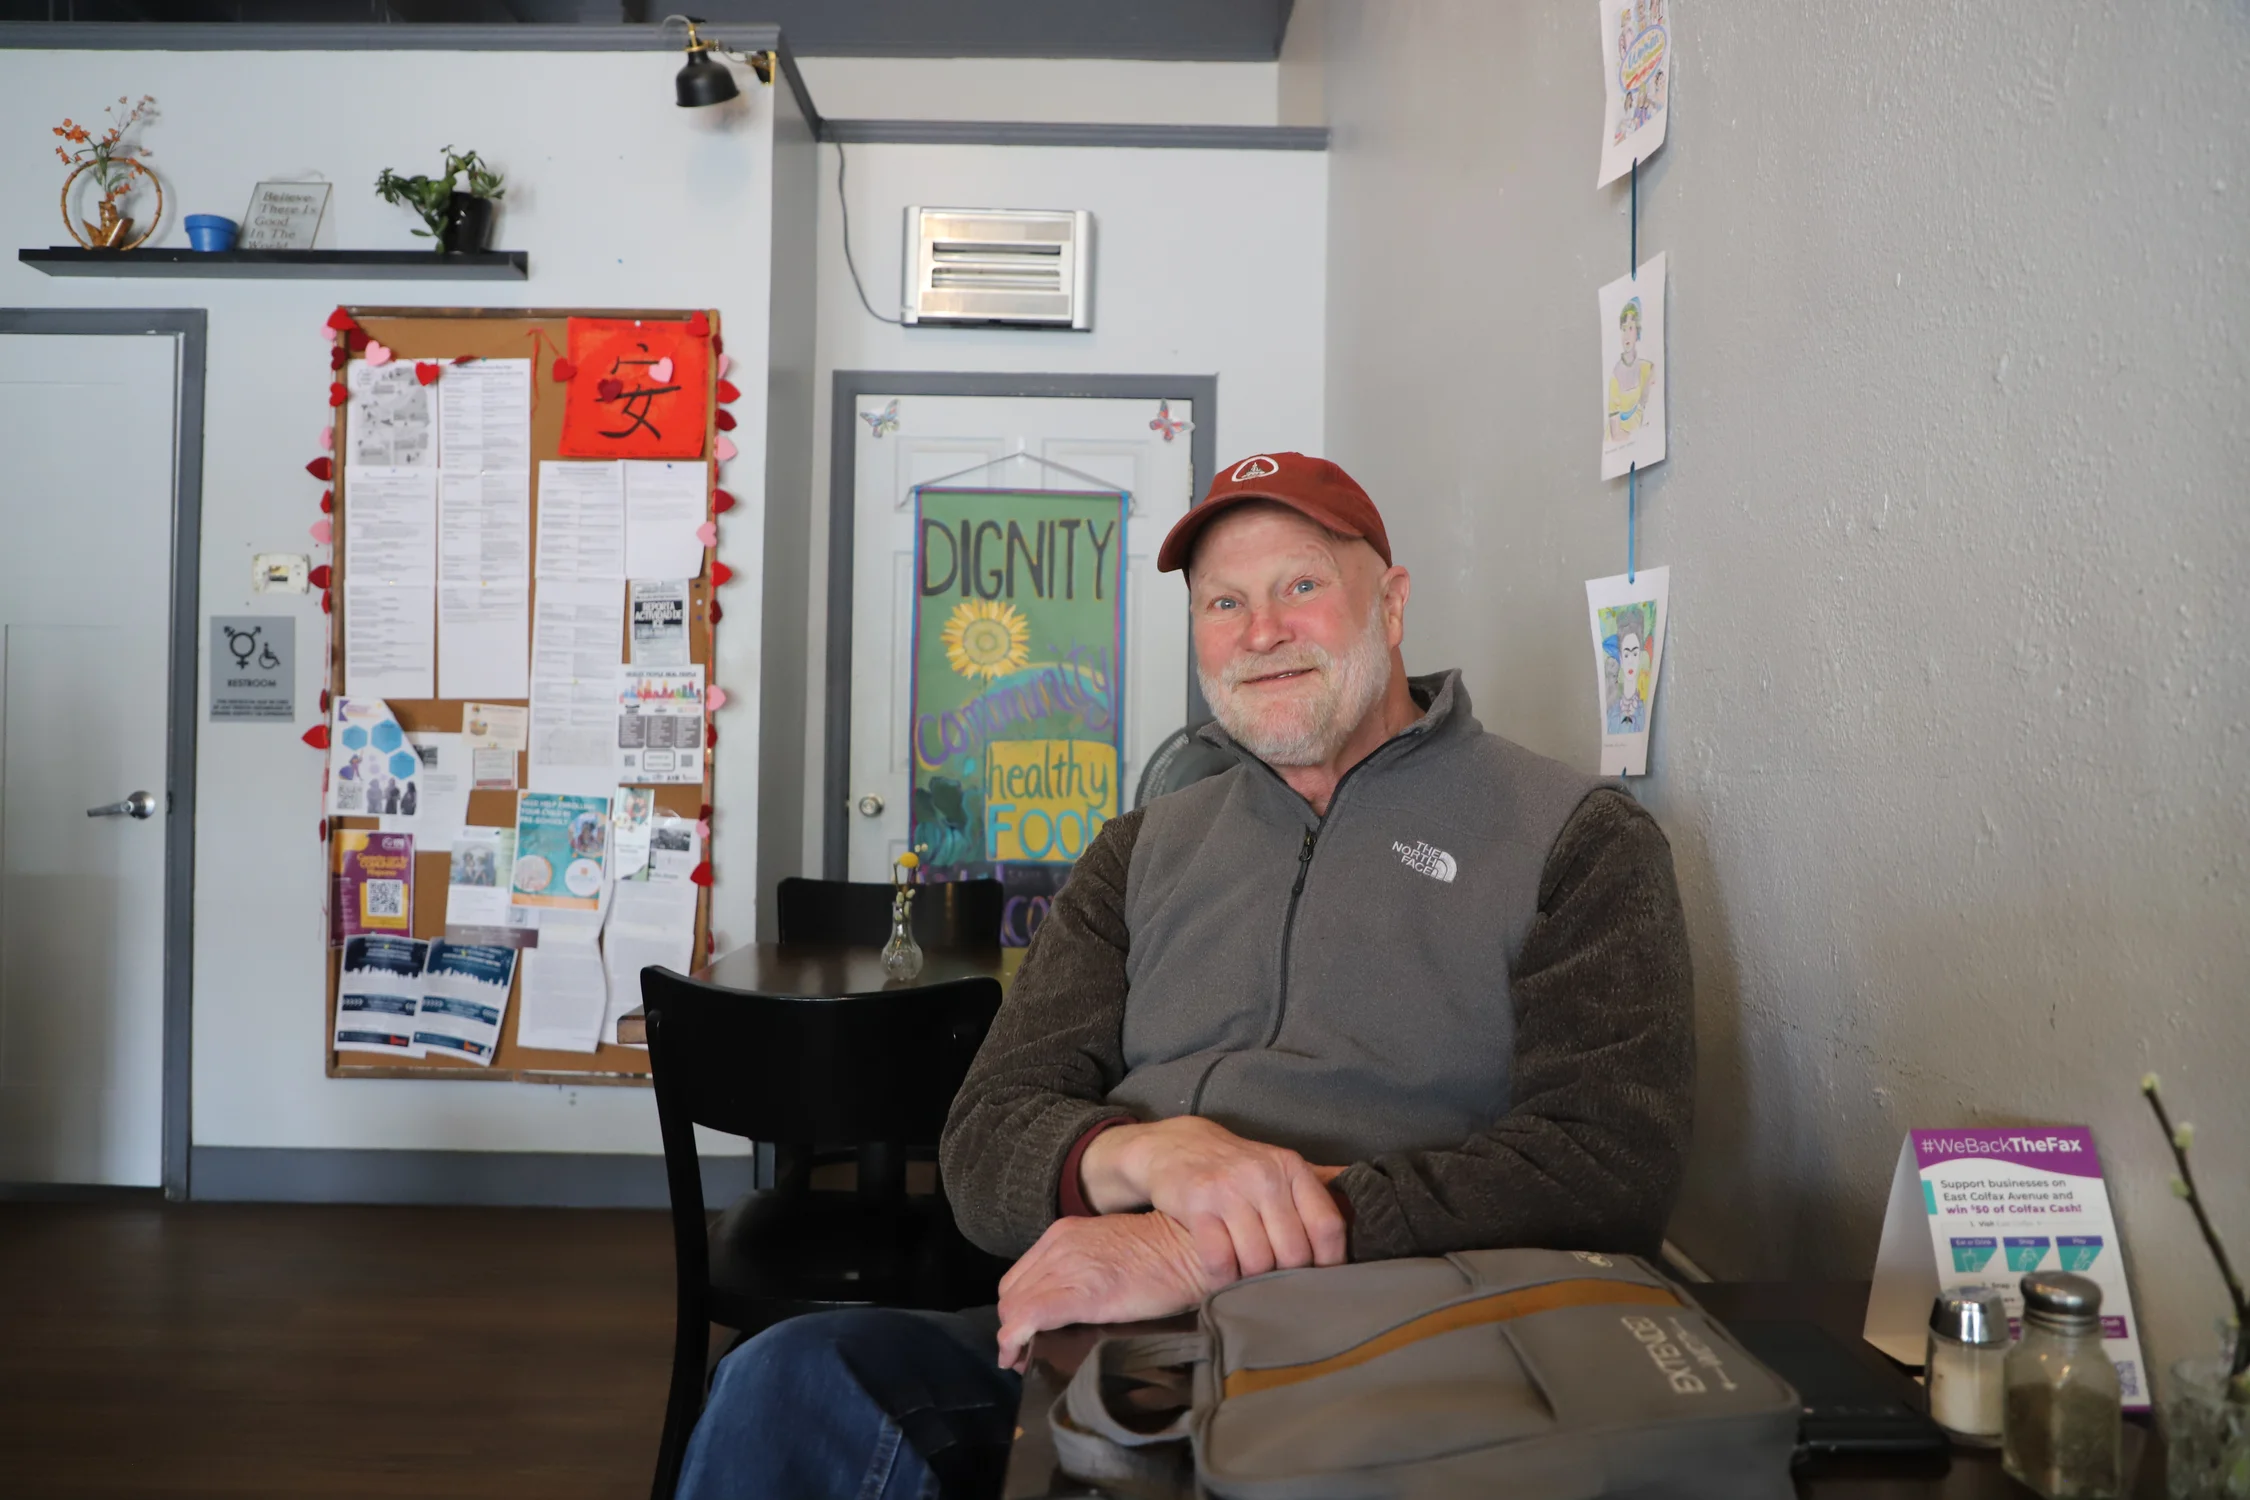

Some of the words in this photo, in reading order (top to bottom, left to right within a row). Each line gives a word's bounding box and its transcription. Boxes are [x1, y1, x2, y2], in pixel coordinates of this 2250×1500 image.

[261, 203, 299, 214] There
[272, 228, 296, 239] The
[921, 517, 1116, 600] DIGNITY
[227, 679, 277, 688] RESTROOM
[987, 739, 1109, 809] healthy
[1392, 841, 1437, 867] NORTH
[1417, 841, 1441, 859] THE
[1401, 855, 1433, 875] FACE
[1921, 1137, 2083, 1154] #WeBackTheFax
[1940, 1179, 1985, 1190] Support
[1988, 1178, 2049, 1189] businesses
[1943, 1193, 1967, 1201] East
[1970, 1192, 2004, 1201] Colfax
[2008, 1192, 2049, 1201] Avenue
[2052, 1191, 2074, 1200] and
[1946, 1205, 1968, 1215] win
[1970, 1204, 1989, 1214] $50
[1993, 1204, 2005, 1214] of
[2008, 1204, 2046, 1213] Colfax
[2049, 1204, 2082, 1213] Cash!
